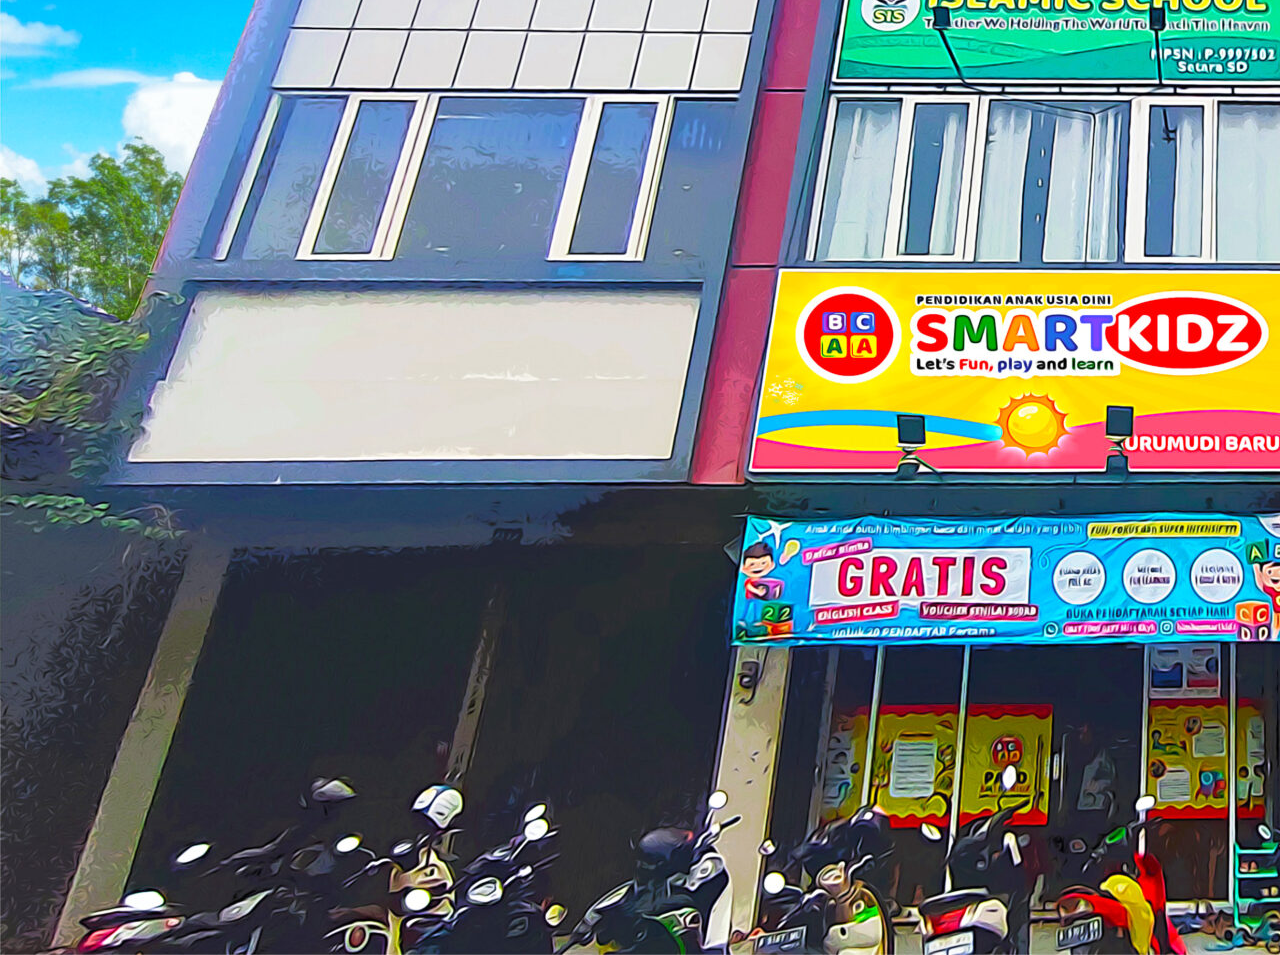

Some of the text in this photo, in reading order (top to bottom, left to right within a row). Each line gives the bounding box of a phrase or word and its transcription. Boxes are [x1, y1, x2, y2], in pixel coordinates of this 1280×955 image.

[873, 9, 905, 24] SIS
[1009, 18, 1061, 33] Holding
[1063, 19, 1088, 32] The
[1226, 60, 1249, 74] SD
[916, 295, 1112, 306] PENDIDIKAN ANAK USIA DINI
[916, 356, 1115, 375] Let's Fun, play and learn
[837, 555, 1008, 598] GRATIS
[817, 603, 894, 621] ENGLISH CLASS
[1066, 608, 1094, 619] BUKA
